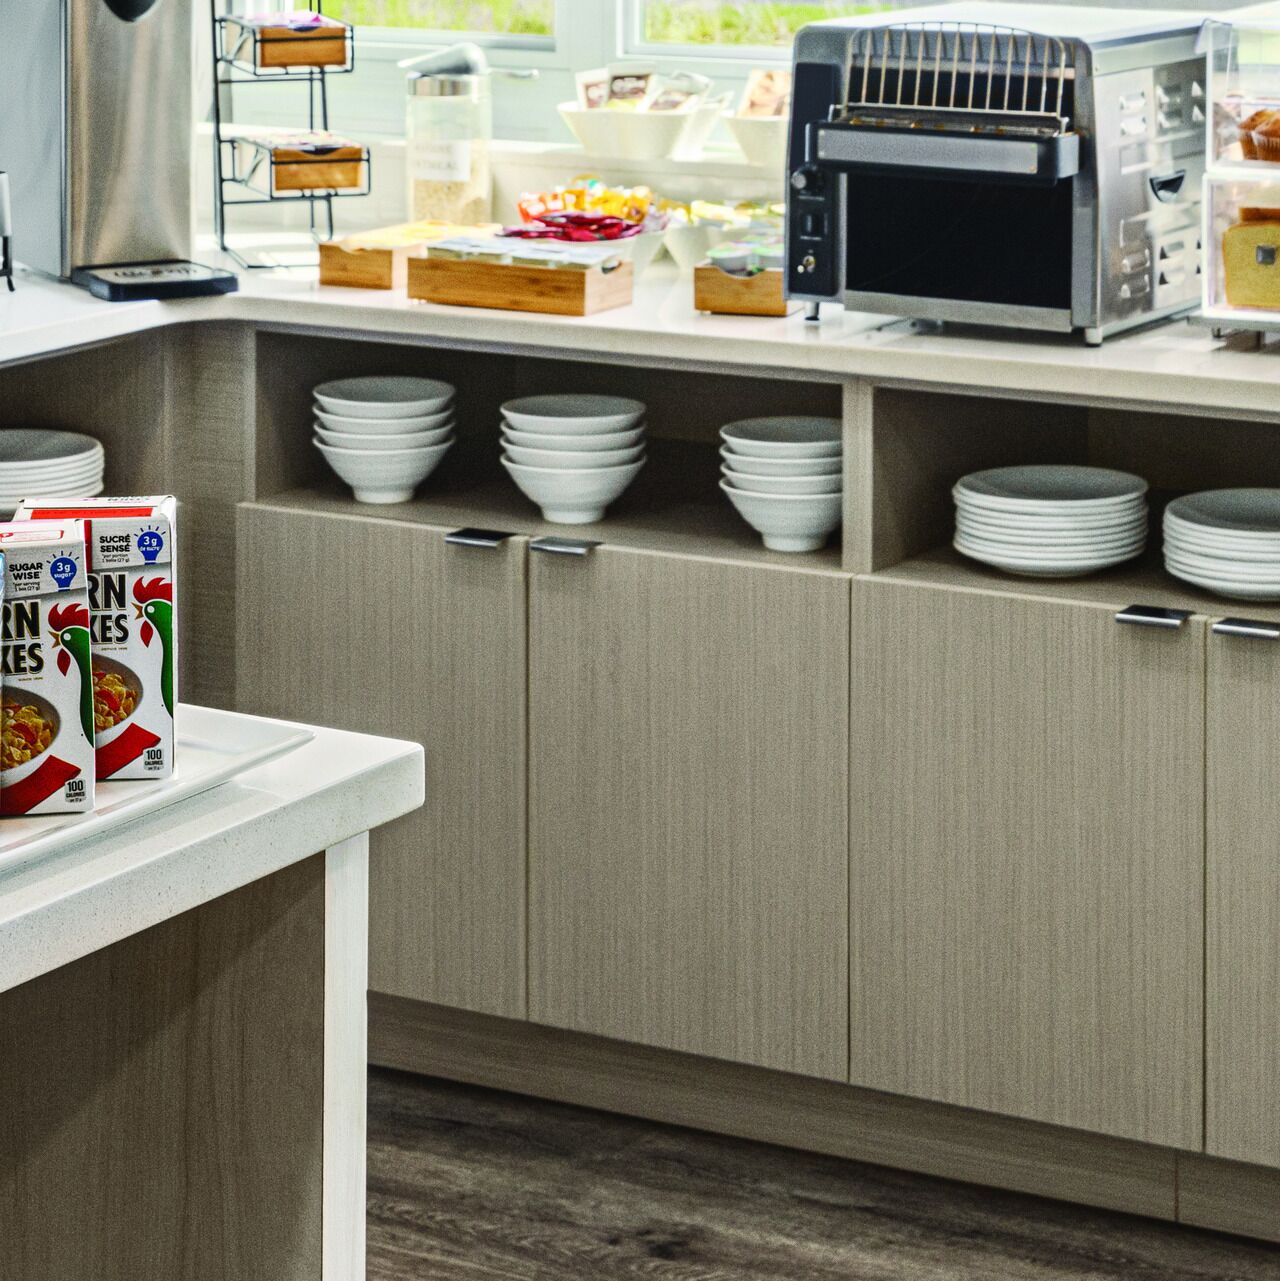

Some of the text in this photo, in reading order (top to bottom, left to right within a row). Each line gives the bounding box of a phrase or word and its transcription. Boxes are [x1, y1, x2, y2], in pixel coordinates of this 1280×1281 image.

[99, 534, 131, 543] SUCRÉ
[144, 536, 150, 545] 3
[100, 543, 131, 552] SENSÉ
[9, 563, 43, 572] SUGAR
[57, 563, 70, 572] 3 g
[13, 572, 41, 580] WISE
[87, 572, 128, 611] RN
[2, 600, 41, 641] RN
[90, 613, 129, 645] KES
[1, 643, 44, 675] KES
[146, 749, 162, 760] 100
[67, 780, 83, 792] 100
